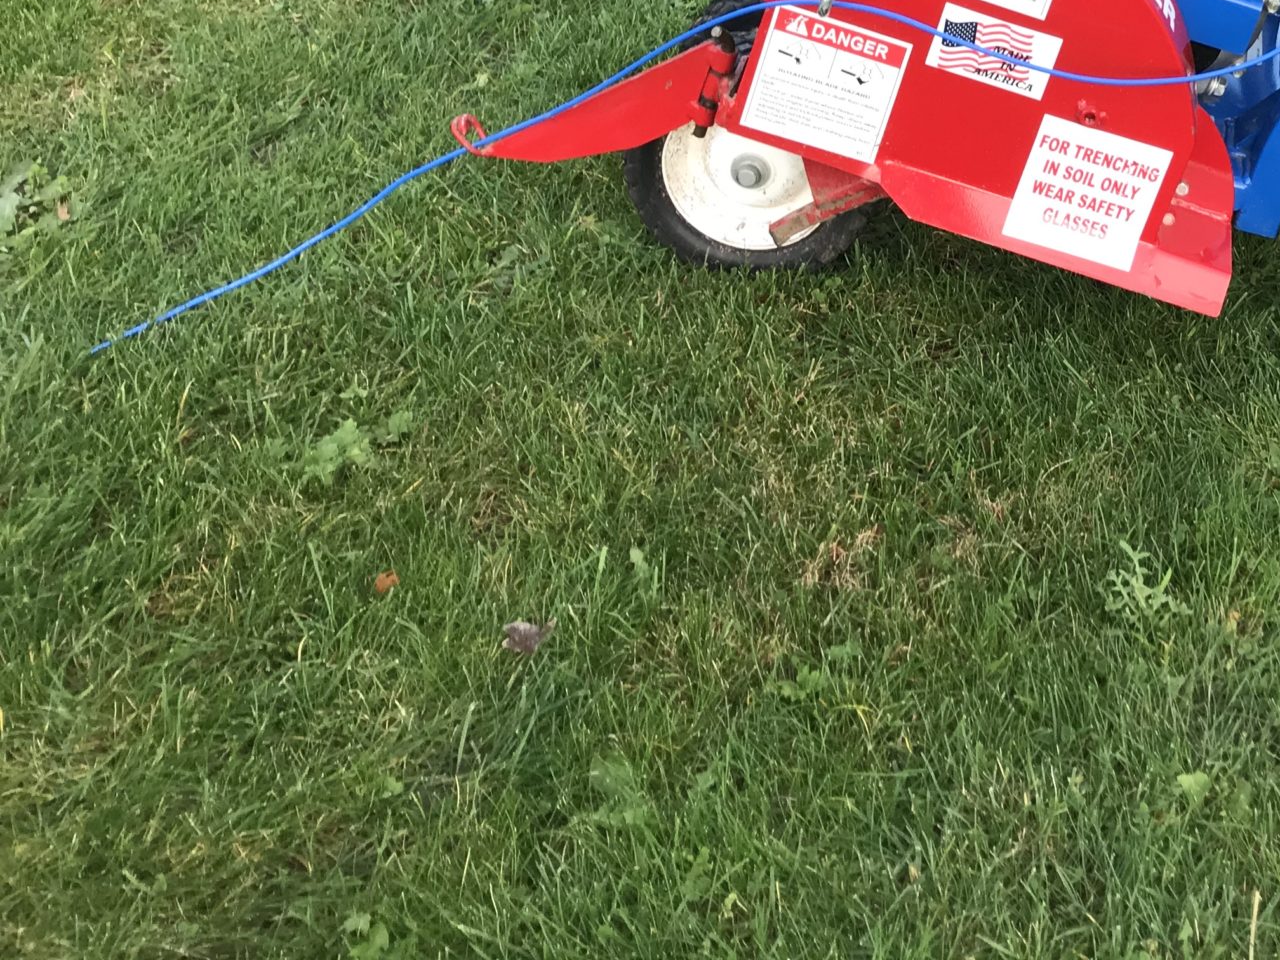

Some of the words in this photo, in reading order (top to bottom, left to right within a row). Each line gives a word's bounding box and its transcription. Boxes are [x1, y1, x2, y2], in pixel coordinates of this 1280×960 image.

[811, 23, 889, 60] DANGER
[993, 45, 1032, 64] MADE
[964, 67, 1033, 92] AMERICA
[1000, 61, 1016, 74] IN
[1039, 134, 1070, 155] FOR
[1074, 144, 1160, 183] TRENCHING
[1043, 159, 1061, 176] IN
[1063, 165, 1095, 188] SOIL
[1100, 177, 1141, 201] ONLY
[1032, 179, 1076, 205] WEAR
[1077, 194, 1136, 222] SAFETY
[1042, 207, 1109, 240] GLASSES
